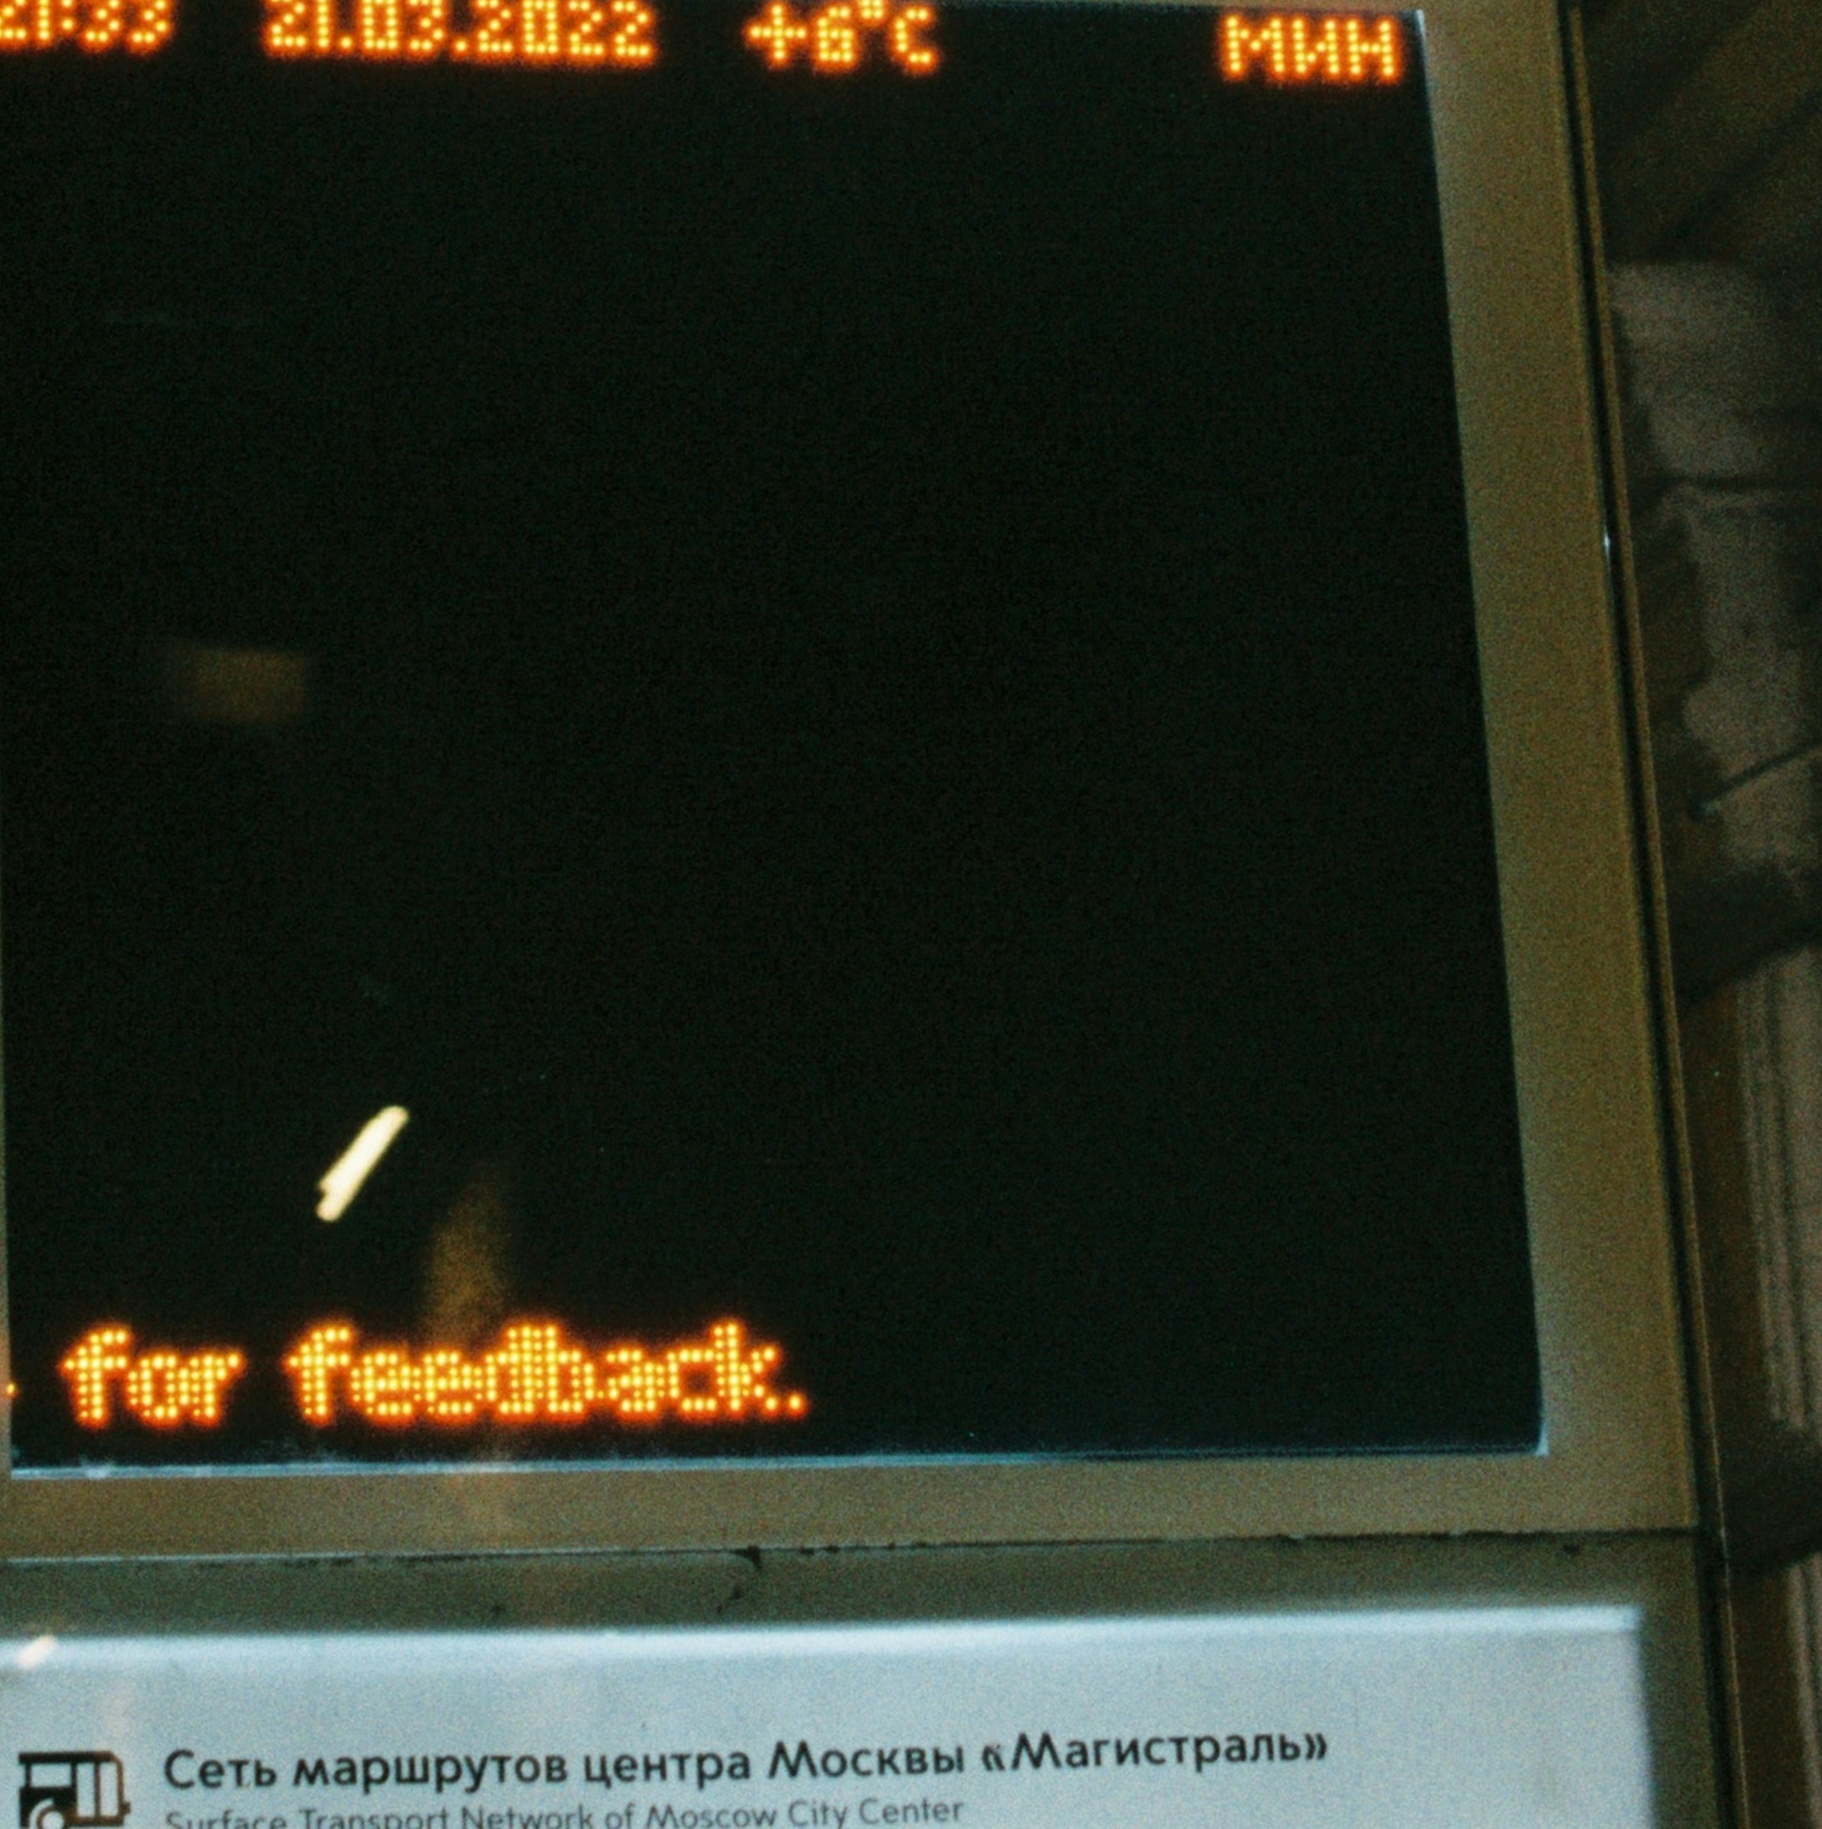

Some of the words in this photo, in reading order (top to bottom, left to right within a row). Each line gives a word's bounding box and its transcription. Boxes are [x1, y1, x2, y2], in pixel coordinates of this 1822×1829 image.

[1223, 13, 1401, 81] МИН
[61, 1321, 243, 1423] for
[287, 1319, 807, 1421] feedback.
[164, 1748, 276, 1791] Сеть
[293, 1753, 568, 1795] маршрутов
[584, 1750, 751, 1791] центра
[769, 1739, 964, 1780] Москвы
[981, 1731, 1328, 1773] «Магистраль»
[165, 1809, 287, 1829] Surface
[299, 1806, 448, 1829] Transport
[461, 1803, 594, 1829] Network
[605, 1802, 636, 1829] of
[646, 1803, 777, 1829] Moscow
[787, 1798, 848, 1829] City
[859, 1797, 964, 1825] Center
